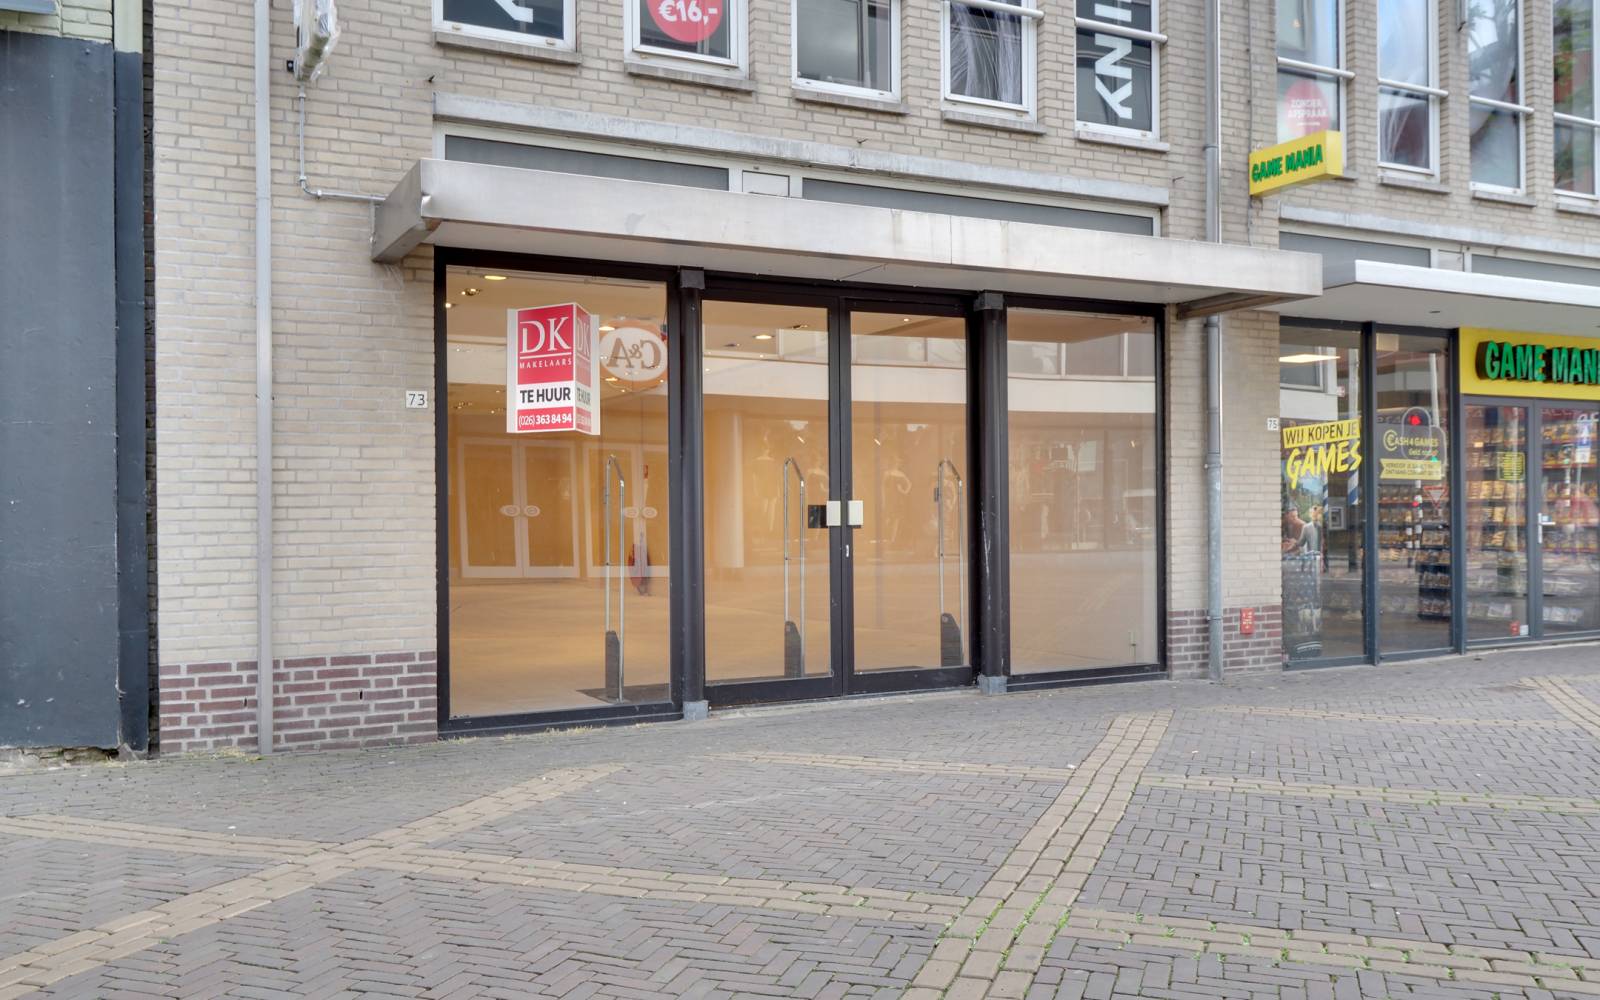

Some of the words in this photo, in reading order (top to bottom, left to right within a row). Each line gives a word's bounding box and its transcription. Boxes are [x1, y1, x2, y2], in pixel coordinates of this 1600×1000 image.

[658, 0, 718, 26] €16,-
[1094, 0, 1132, 119] INY
[1251, 156, 1283, 182] GAME
[1285, 144, 1323, 173] MANIA
[520, 317, 571, 353] DK
[520, 358, 572, 369] MAKELAARS
[1476, 340, 1547, 382] GAME
[408, 393, 426, 406] 73
[520, 389, 534, 404] TE
[536, 386, 571, 403] HUUR
[519, 415, 535, 429] (026)
[536, 414, 550, 425] 363
[1267, 419, 1278, 429] 75
[1285, 427, 1304, 445] WIJ
[1308, 423, 1344, 442] KOPEN
[1287, 441, 1362, 490] GAMES
